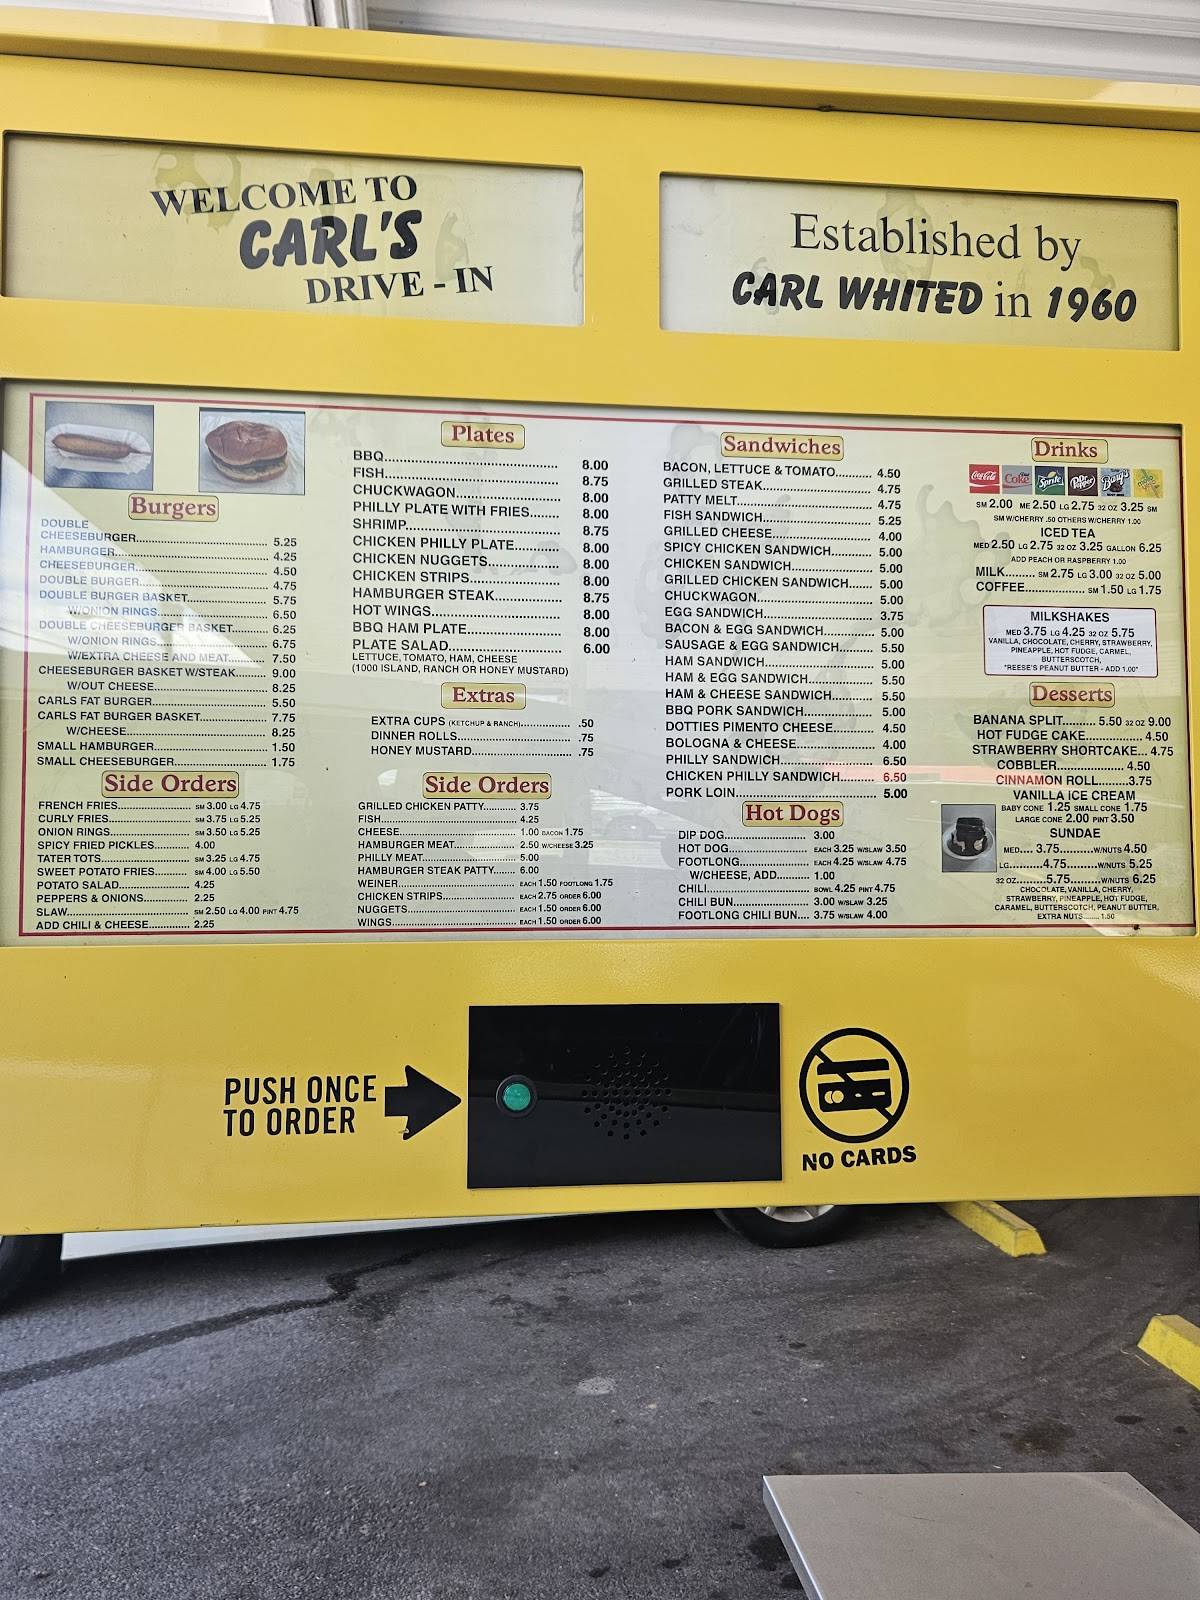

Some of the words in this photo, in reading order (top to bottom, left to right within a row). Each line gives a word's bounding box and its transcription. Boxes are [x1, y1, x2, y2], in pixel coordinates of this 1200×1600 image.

[150, 179, 357, 217] WELCOME
[365, 175, 417, 202] TO
[240, 210, 422, 269] CARL'S
[791, 212, 1020, 259] Established
[1035, 225, 1081, 272] by
[305, 271, 424, 304] DRIVE
[453, 266, 494, 294] IN
[732, 271, 823, 309] CARL
[839, 276, 982, 315] WHITED
[995, 281, 1032, 317] in
[1047, 286, 1136, 322] 1960
[451, 425, 514, 443] Plates
[723, 436, 841, 456] Sandwiches
[1035, 441, 1097, 458] Drinks
[582, 460, 609, 470] 8.00
[663, 462, 711, 474] BACON,
[714, 463, 770, 475] LETTUCE
[775, 465, 782, 475] &
[877, 468, 900, 478] 4.50
[1005, 473, 1030, 483] Coke
[1039, 476, 1061, 488] Sprite
[131, 496, 216, 519] Burgers
[353, 502, 400, 513] PHILLY
[405, 503, 448, 515] PLATE
[452, 505, 486, 516] WITH
[583, 509, 609, 519] 8.00
[989, 499, 1012, 509] 2.00
[1033, 500, 1056, 510] 2.50
[1071, 501, 1094, 511] 2.75
[1121, 502, 1143, 512] 3.25
[1041, 528, 1069, 538] ICED
[1071, 528, 1095, 538] TEA
[1100, 585, 1123, 594] 1.50
[1138, 586, 1161, 595] 1.75
[39, 591, 86, 601] DOUBLE
[90, 592, 139, 601] BURGER
[272, 596, 297, 605] 5.75
[1031, 611, 1109, 622] MILKSHAKES
[352, 640, 397, 651] PLATE
[584, 643, 610, 654] 6.00
[1022, 638, 1068, 646] CHOCOLATE,
[1070, 639, 1100, 647] CHERRY,
[352, 653, 401, 663] LETTUCE,
[403, 653, 446, 663] TOMATO,
[449, 654, 475, 663] HAM,
[477, 654, 517, 663] CHEESE
[38, 666, 134, 676] CHEESEBURGER
[137, 667, 183, 677] BASKET
[272, 668, 296, 678] 9.00
[352, 664, 378, 673] (1000
[381, 664, 421, 673] ISLAND,
[423, 665, 459, 674] RANCH
[462, 665, 476, 674] OR
[479, 665, 514, 675] HONEY
[517, 666, 569, 676] MUSTARD)
[452, 687, 515, 703] Extras
[665, 689, 695, 699] HAM
[698, 689, 706, 699] &
[710, 689, 761, 700] CHEESE
[882, 692, 905, 702] 5.50
[1032, 686, 1112, 702] Desserts
[371, 716, 410, 726] EXTRA
[414, 716, 445, 726] CUPS
[449, 720, 484, 728] (KETCHUP
[578, 719, 593, 728] .50
[973, 715, 1025, 726] BANANA
[1098, 716, 1122, 727] 5.50
[1148, 717, 1171, 727] 9.00
[37, 756, 77, 767] SMALL
[271, 757, 295, 767] 1.75
[104, 774, 154, 792] Side
[161, 774, 236, 792] Orders
[425, 776, 471, 793] Side
[478, 776, 549, 793] Orders
[996, 775, 1062, 786] CINNAMON
[1128, 776, 1152, 786] 3.75
[666, 787, 702, 798] PORK
[883, 788, 908, 799] 5.00
[38, 801, 83, 810] FRENCH
[206, 802, 226, 810] 3.00
[240, 802, 260, 810] 4.75
[358, 802, 402, 811] GRILLED
[406, 802, 450, 810] CHICKEN
[520, 802, 539, 811] 3.75
[746, 804, 784, 821] Hot
[789, 805, 840, 825] Dogs
[1050, 828, 1100, 838] SUNDAE
[678, 844, 701, 853] HOT
[834, 844, 854, 852] 3.25
[886, 844, 906, 853] 3.50
[538, 879, 557, 887] 1.50
[594, 879, 613, 887] 1.75
[36, 894, 88, 903] PEPPERS
[91, 894, 99, 903] &
[194, 894, 214, 902] 2.25
[206, 907, 226, 915] 2.50
[240, 907, 260, 915] 4.00
[279, 906, 299, 914] 4.75
[678, 911, 740, 920] FOOTLONG
[743, 911, 772, 920] CHILI
[814, 911, 835, 919] 3.75
[866, 911, 888, 919] 4.00
[225, 1078, 297, 1106] PUSH
[309, 1075, 376, 1104] ONCE
[224, 1109, 259, 1137] TO
[267, 1107, 356, 1136] ORDER
[802, 1152, 836, 1172] NO
[842, 1146, 917, 1169] CARDS
